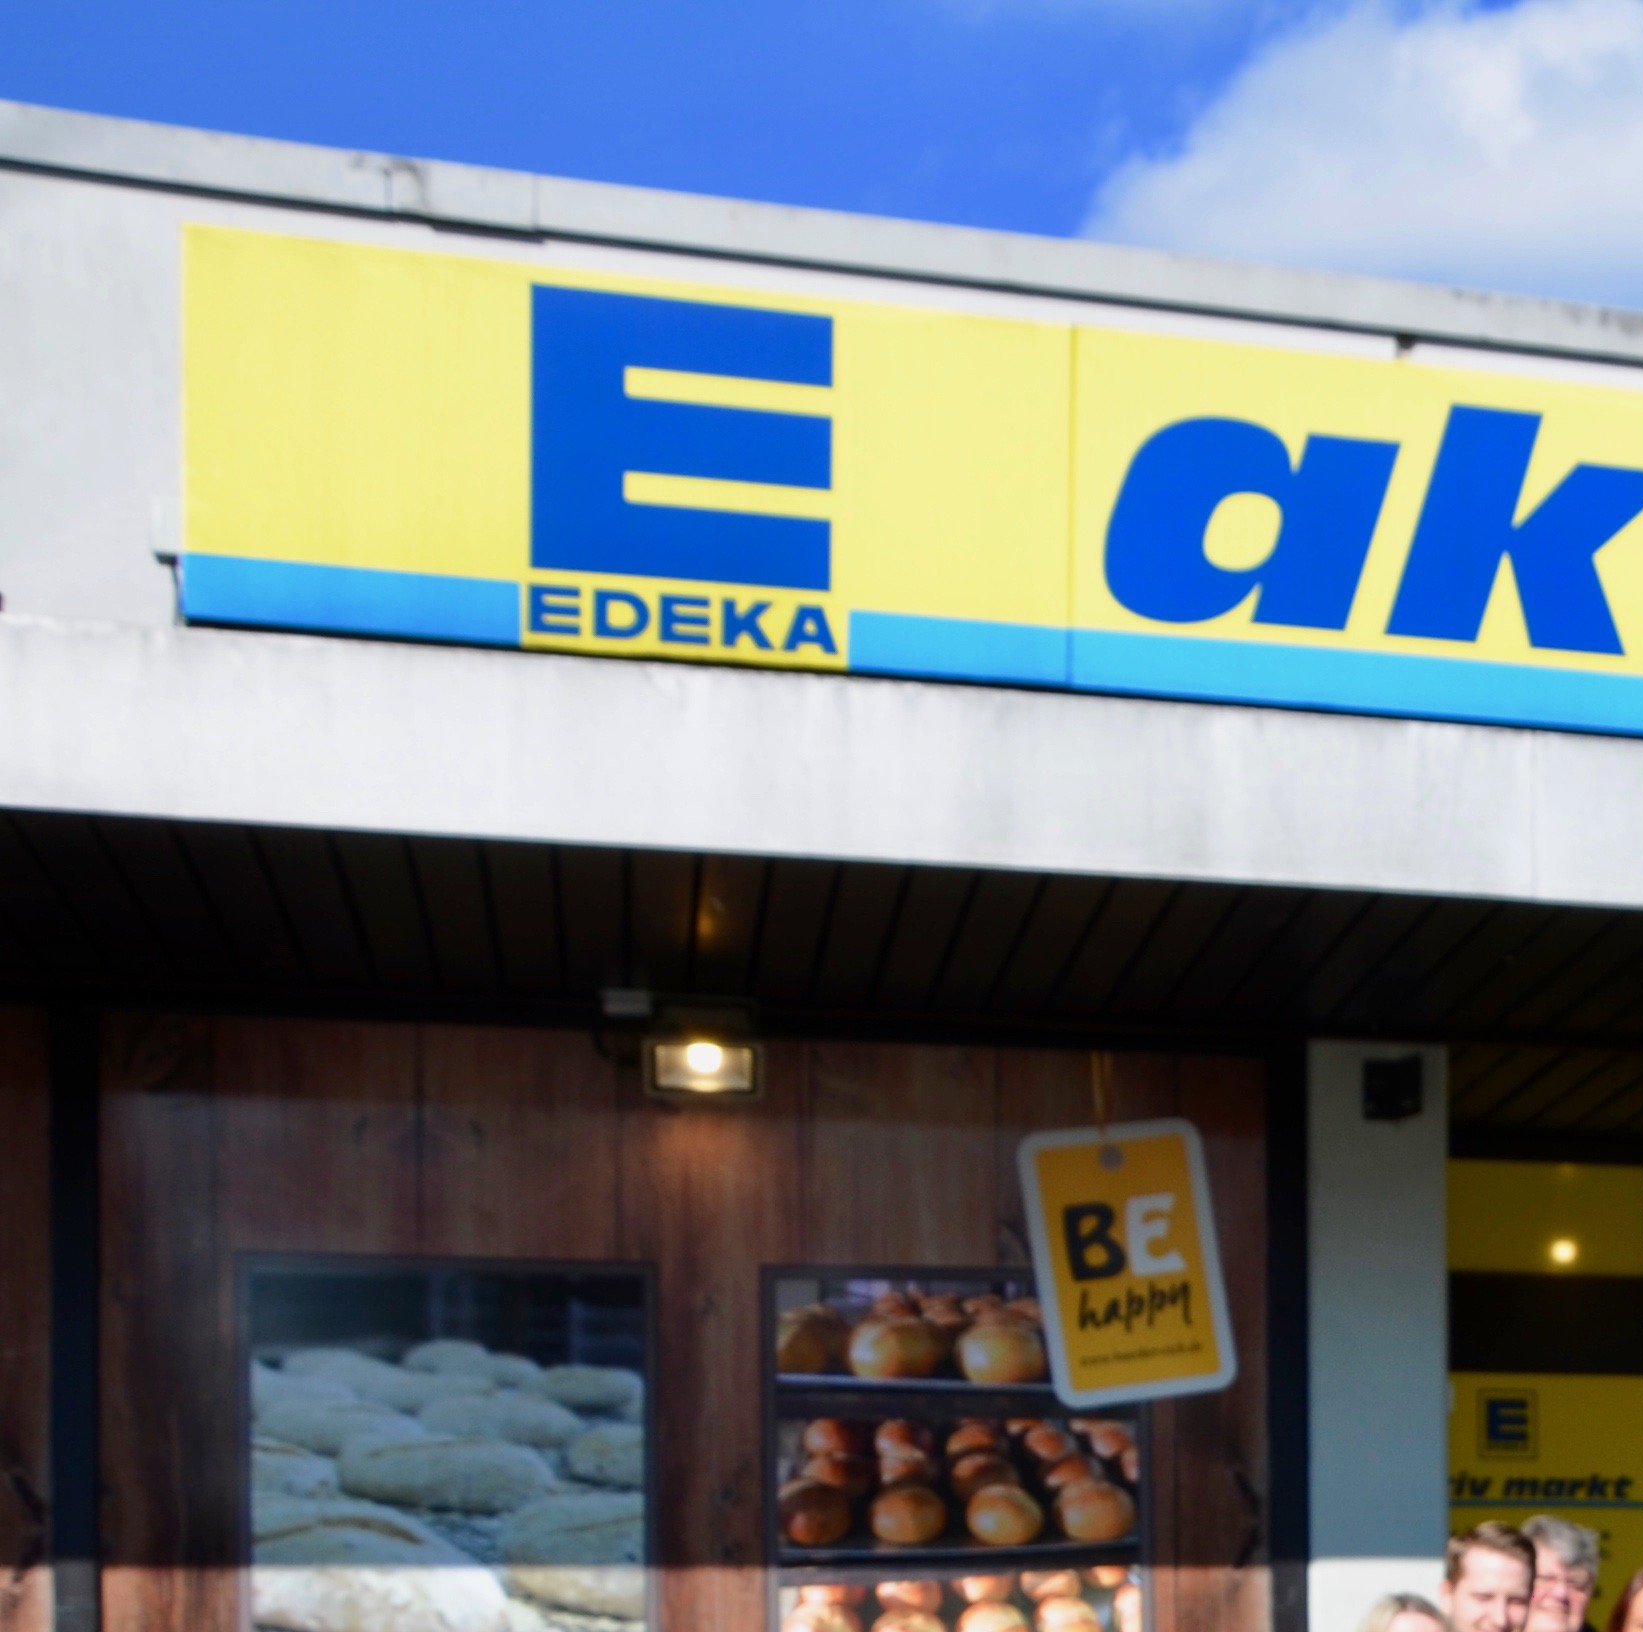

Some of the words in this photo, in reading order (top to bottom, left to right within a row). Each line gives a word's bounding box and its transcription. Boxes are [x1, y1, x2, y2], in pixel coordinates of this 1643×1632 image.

[529, 282, 833, 591] E
[527, 585, 838, 655] EDEKA
[1063, 1193, 1187, 1281] BE
[1078, 1280, 1192, 1333] happy
[1487, 1399, 1528, 1441] E
[1503, 1473, 1634, 1498] markt
